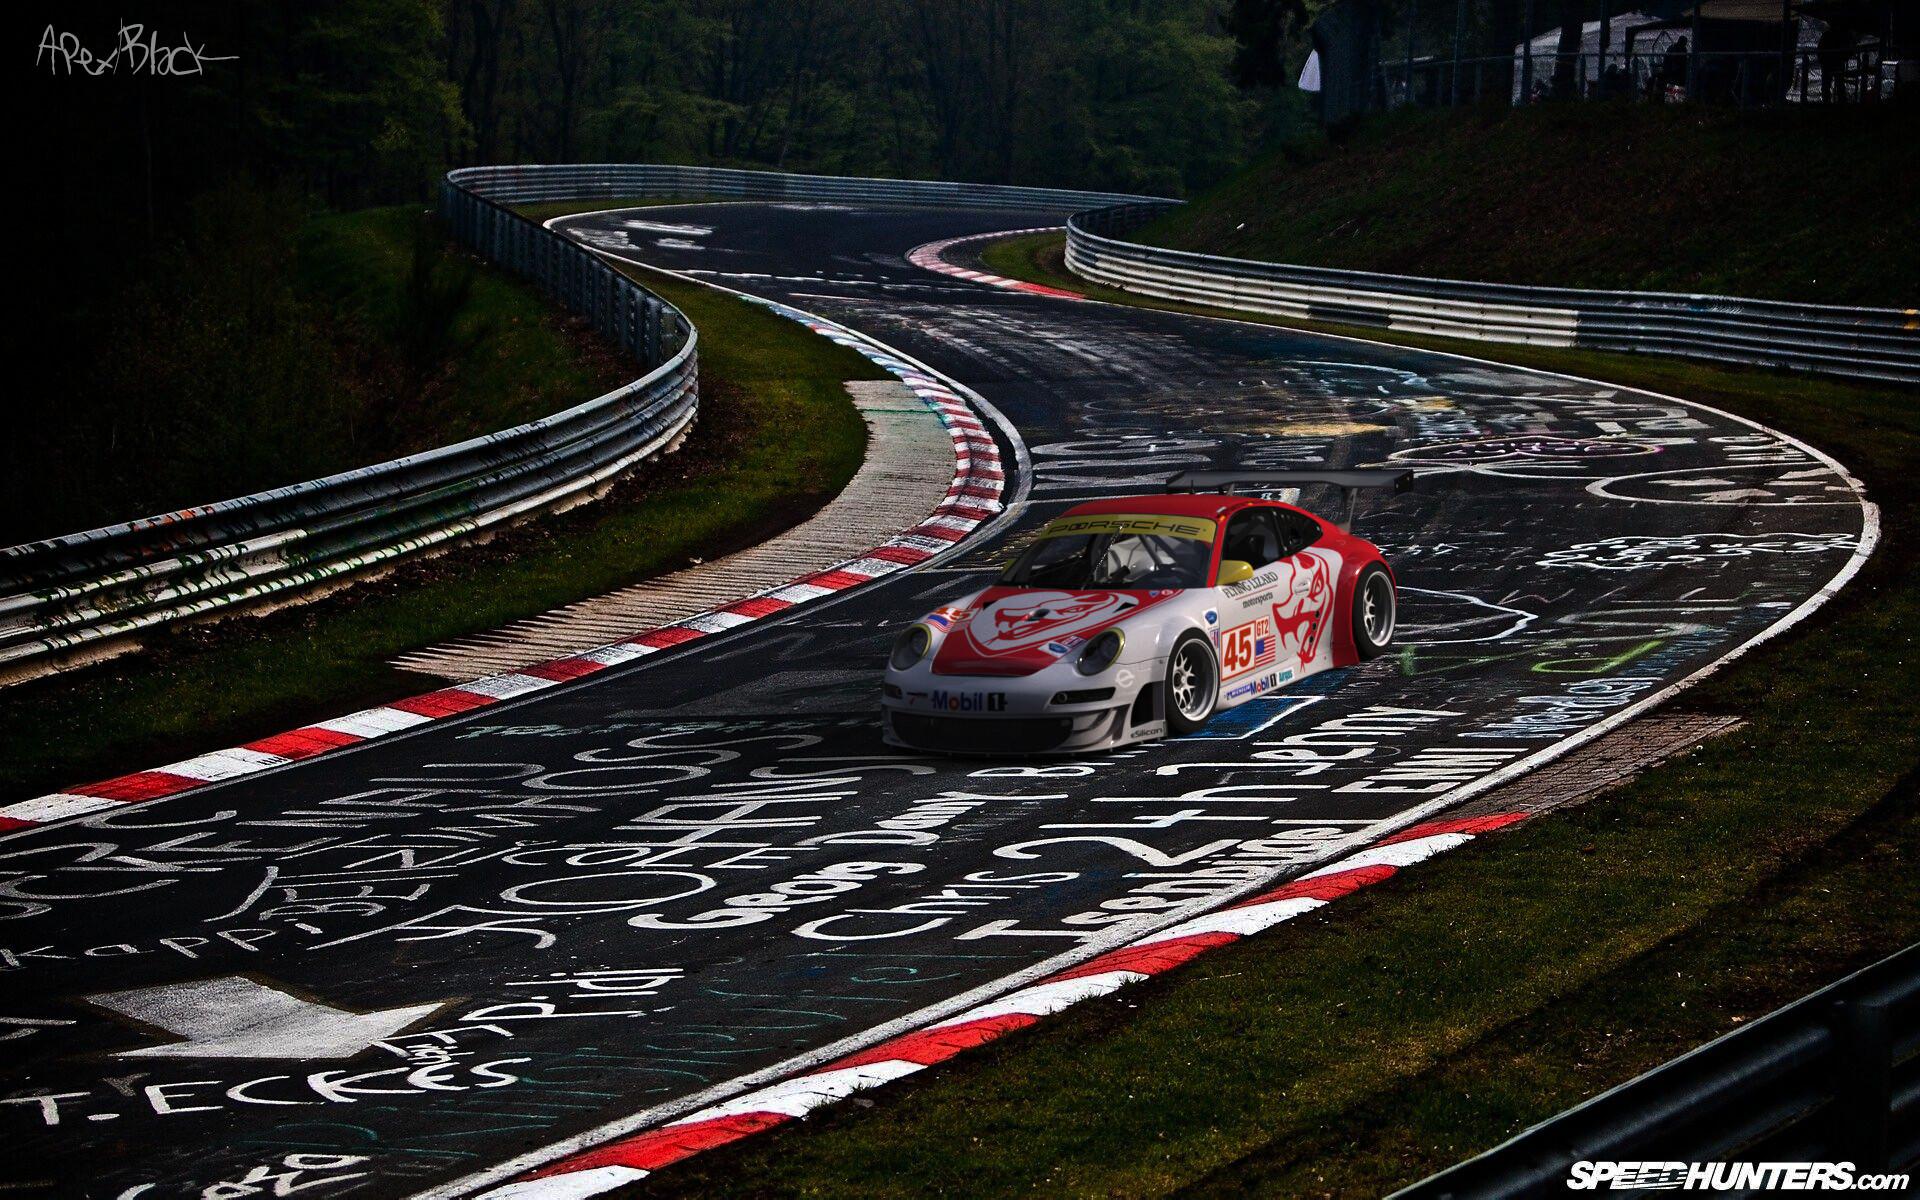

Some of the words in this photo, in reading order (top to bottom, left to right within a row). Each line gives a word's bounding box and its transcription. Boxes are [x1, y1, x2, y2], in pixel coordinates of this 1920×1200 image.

[1047, 519, 1201, 536] PORSCHE
[1222, 579, 1254, 599] FLYING
[1250, 571, 1279, 590] LIZARD
[1242, 591, 1274, 609] motorsports
[1256, 618, 1269, 637] GT2
[1223, 626, 1252, 672] 45
[1249, 676, 1270, 695] Mobil
[932, 689, 983, 712] Mobil
[626, 860, 928, 931] Georg
[795, 789, 1070, 847] Danny
